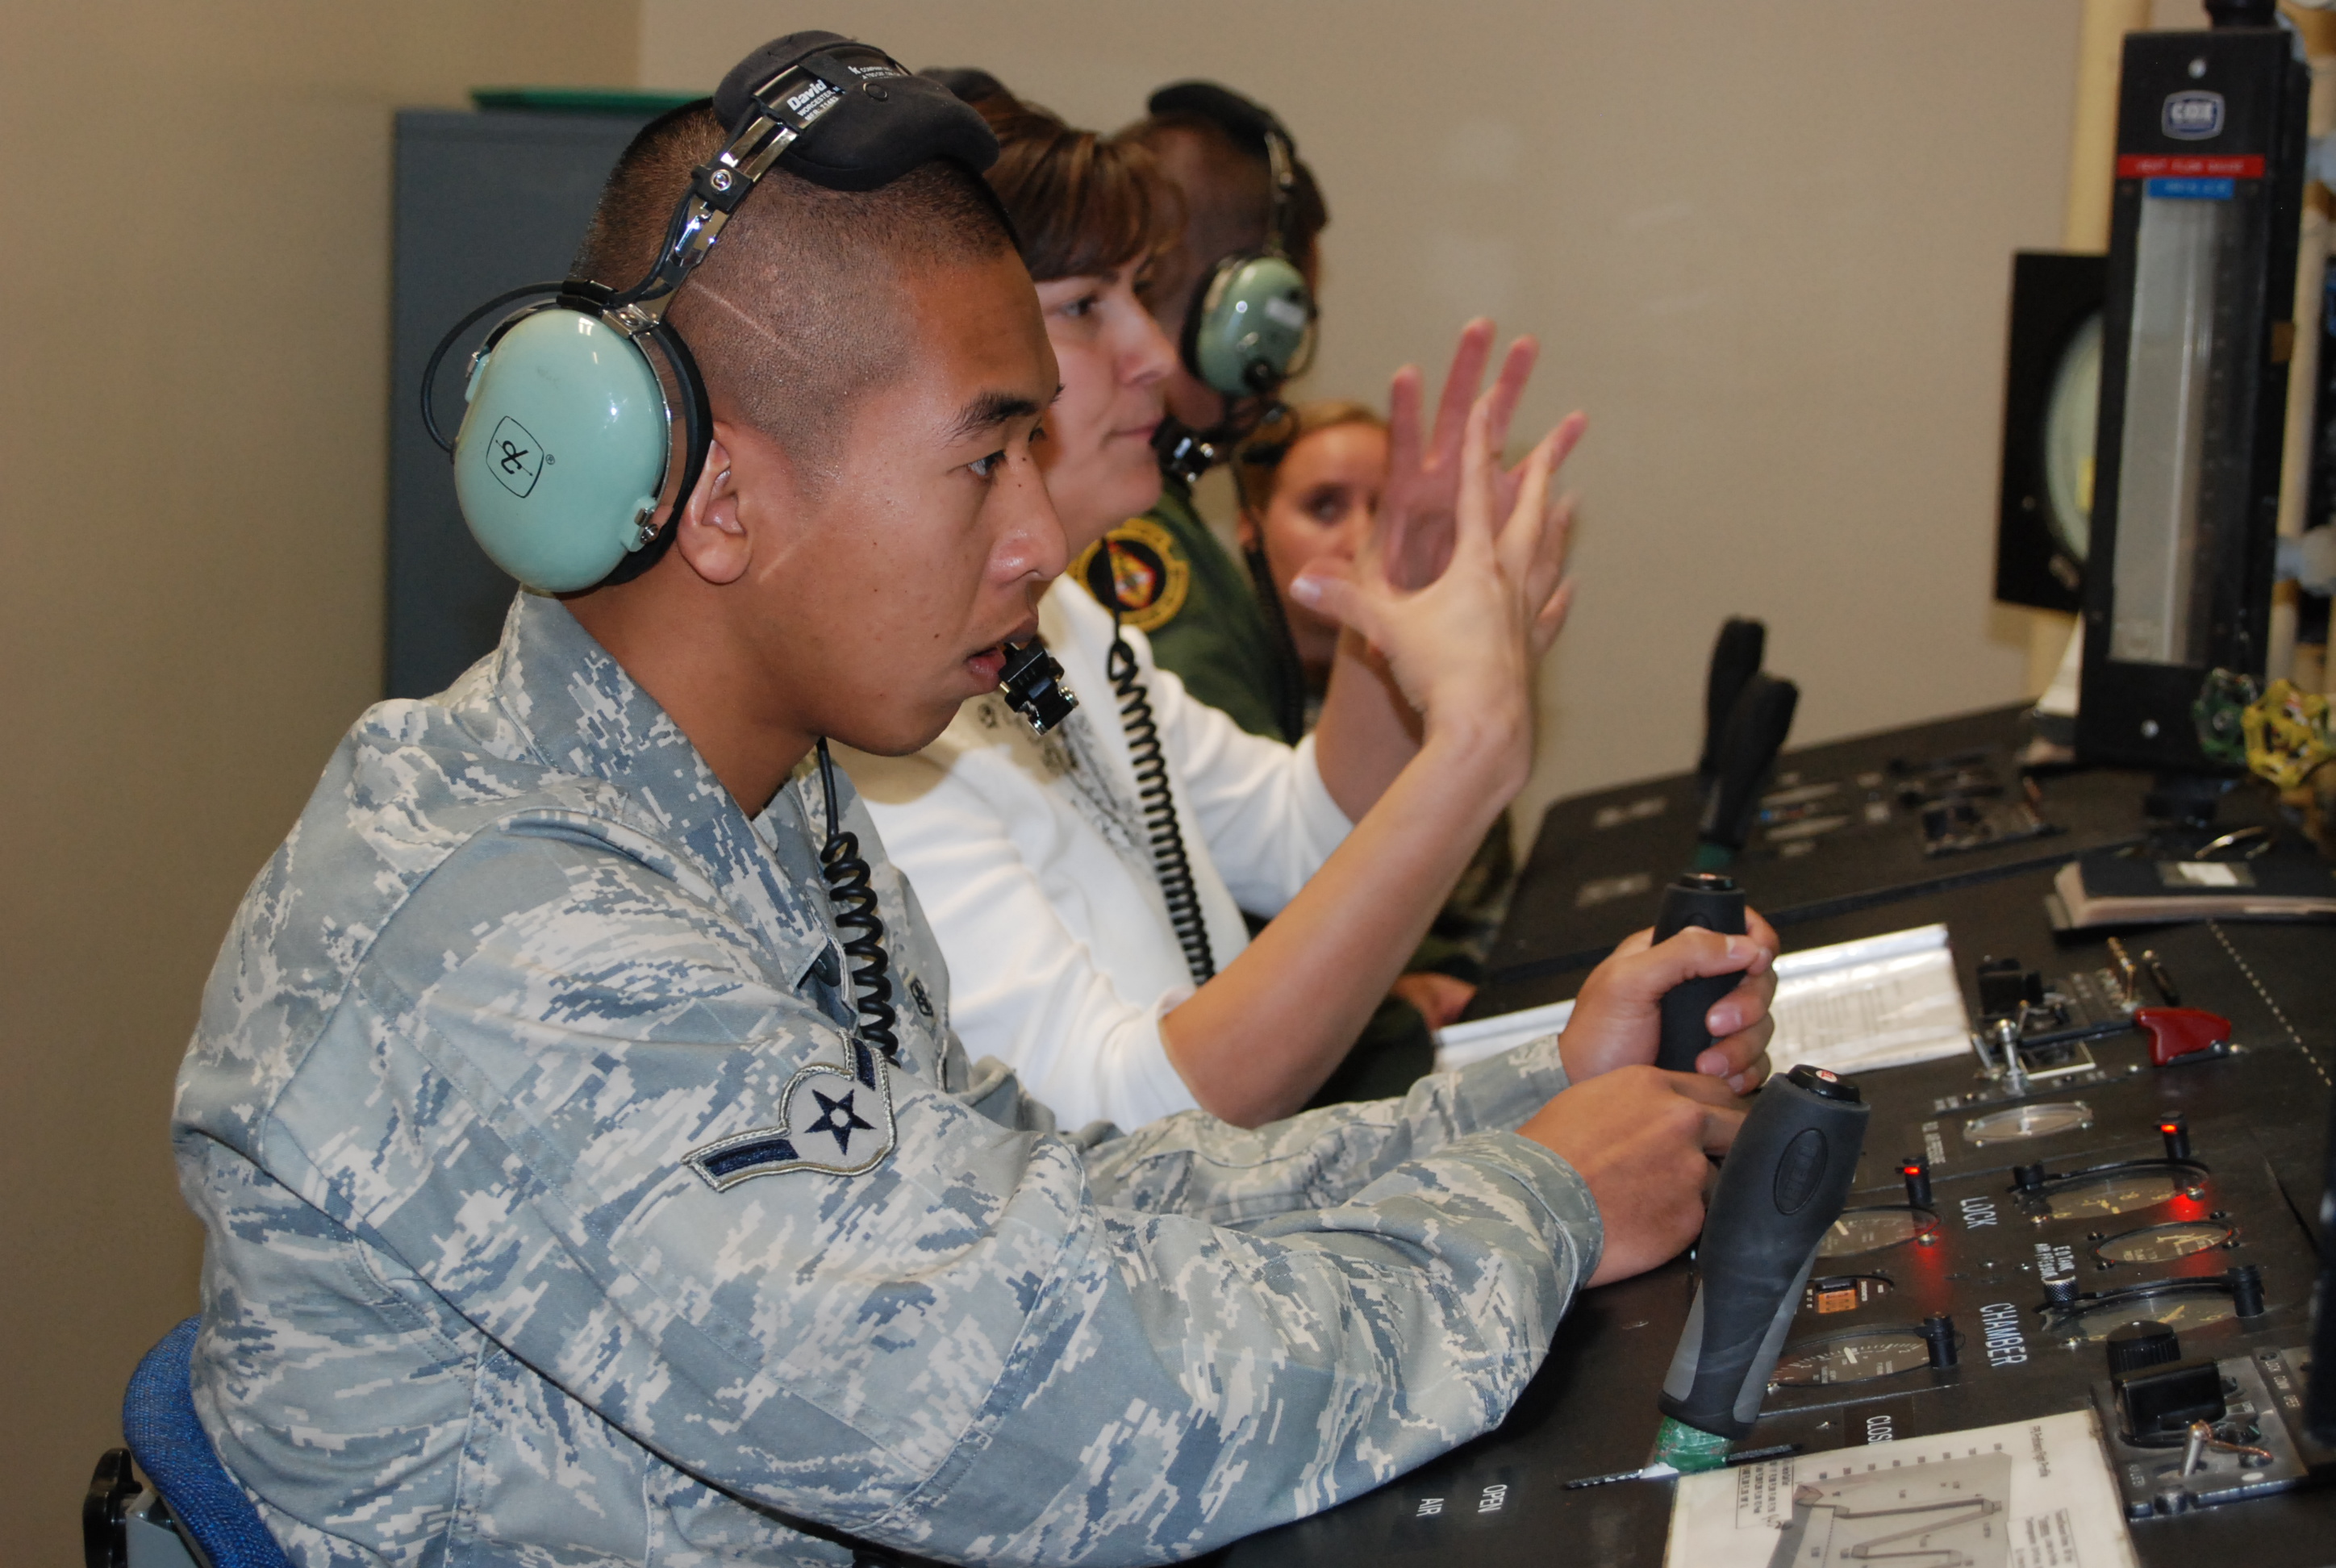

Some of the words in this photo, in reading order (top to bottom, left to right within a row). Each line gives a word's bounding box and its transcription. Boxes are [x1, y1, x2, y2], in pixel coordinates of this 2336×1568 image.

[786, 78, 827, 111] David
[797, 90, 836, 117] WORCESTER,
[1960, 1196, 1997, 1229] LOCK
[1979, 1303, 2027, 1367] CHAMBER
[1866, 1415, 1893, 1445] CLOS
[1416, 1498, 1444, 1516] AIR
[1478, 1484, 1508, 1513] OPEN
